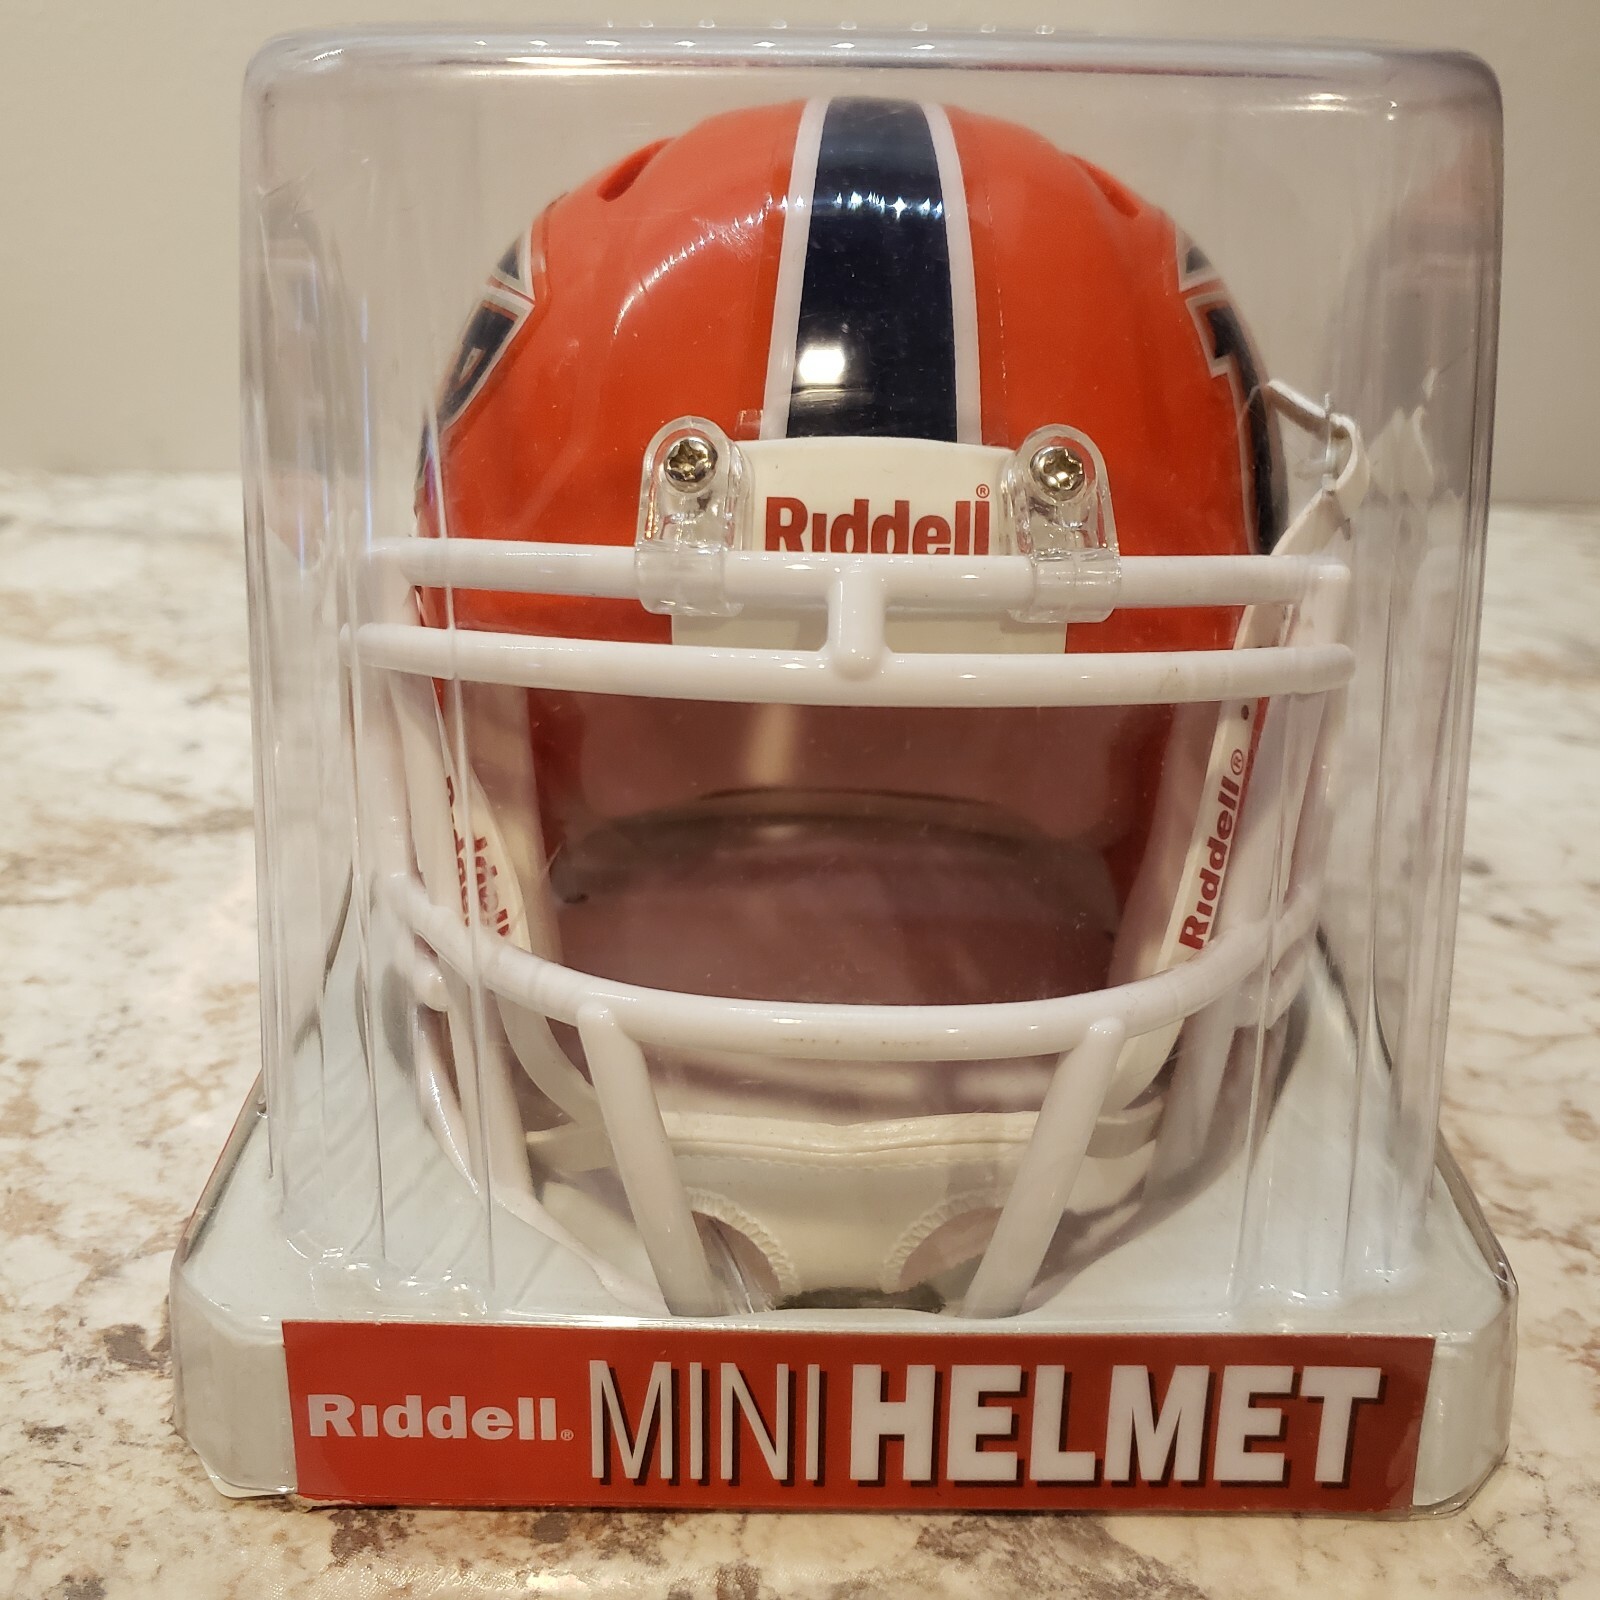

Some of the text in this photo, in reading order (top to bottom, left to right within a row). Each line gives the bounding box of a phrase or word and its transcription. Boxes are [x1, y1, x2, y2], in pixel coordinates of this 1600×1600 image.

[765, 497, 990, 556] Riddell
[1178, 775, 1240, 951] Riddell
[306, 1393, 558, 1442] Riddell
